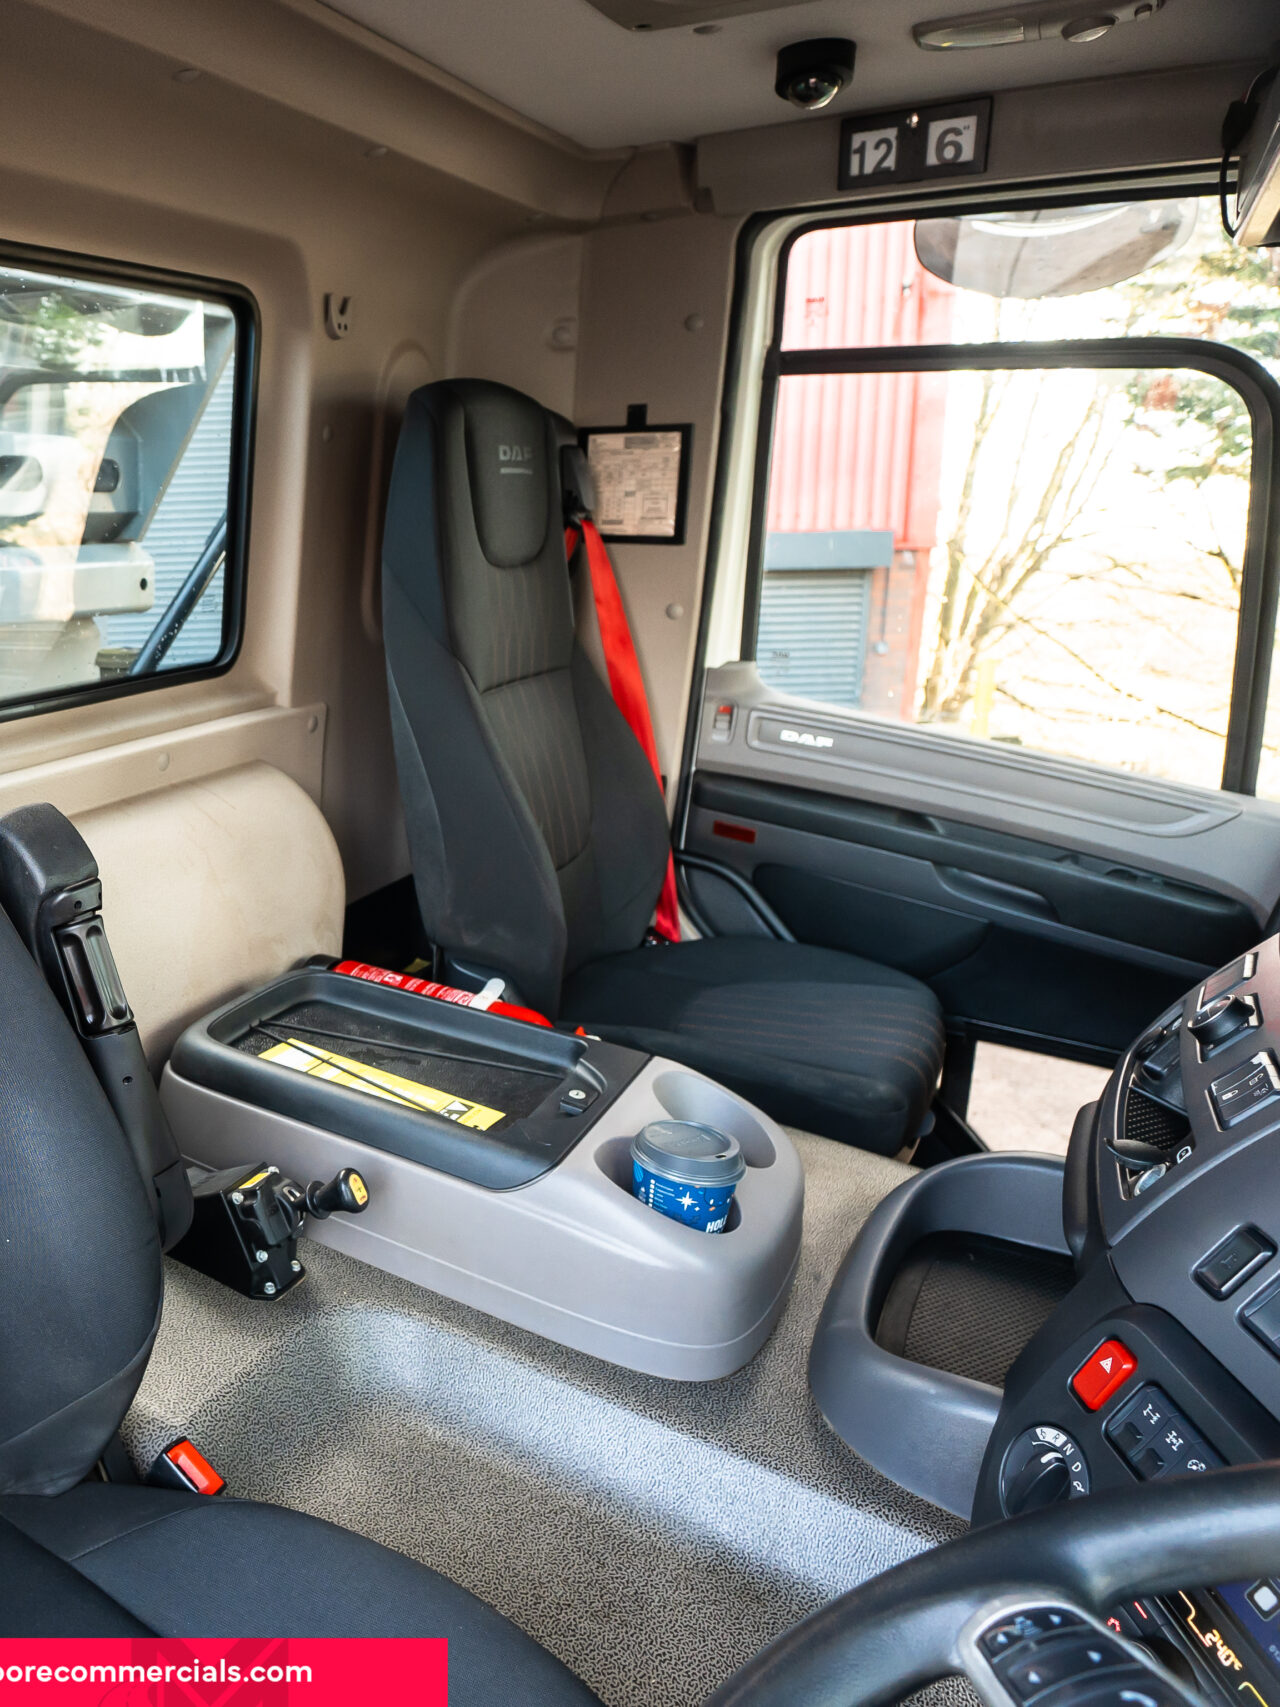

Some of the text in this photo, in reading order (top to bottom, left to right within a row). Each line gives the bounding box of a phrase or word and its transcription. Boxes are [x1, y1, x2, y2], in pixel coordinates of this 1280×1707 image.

[499, 445, 532, 461] DAF
[780, 729, 834, 747] DAF
[1063, 1443, 1075, 1456] N
